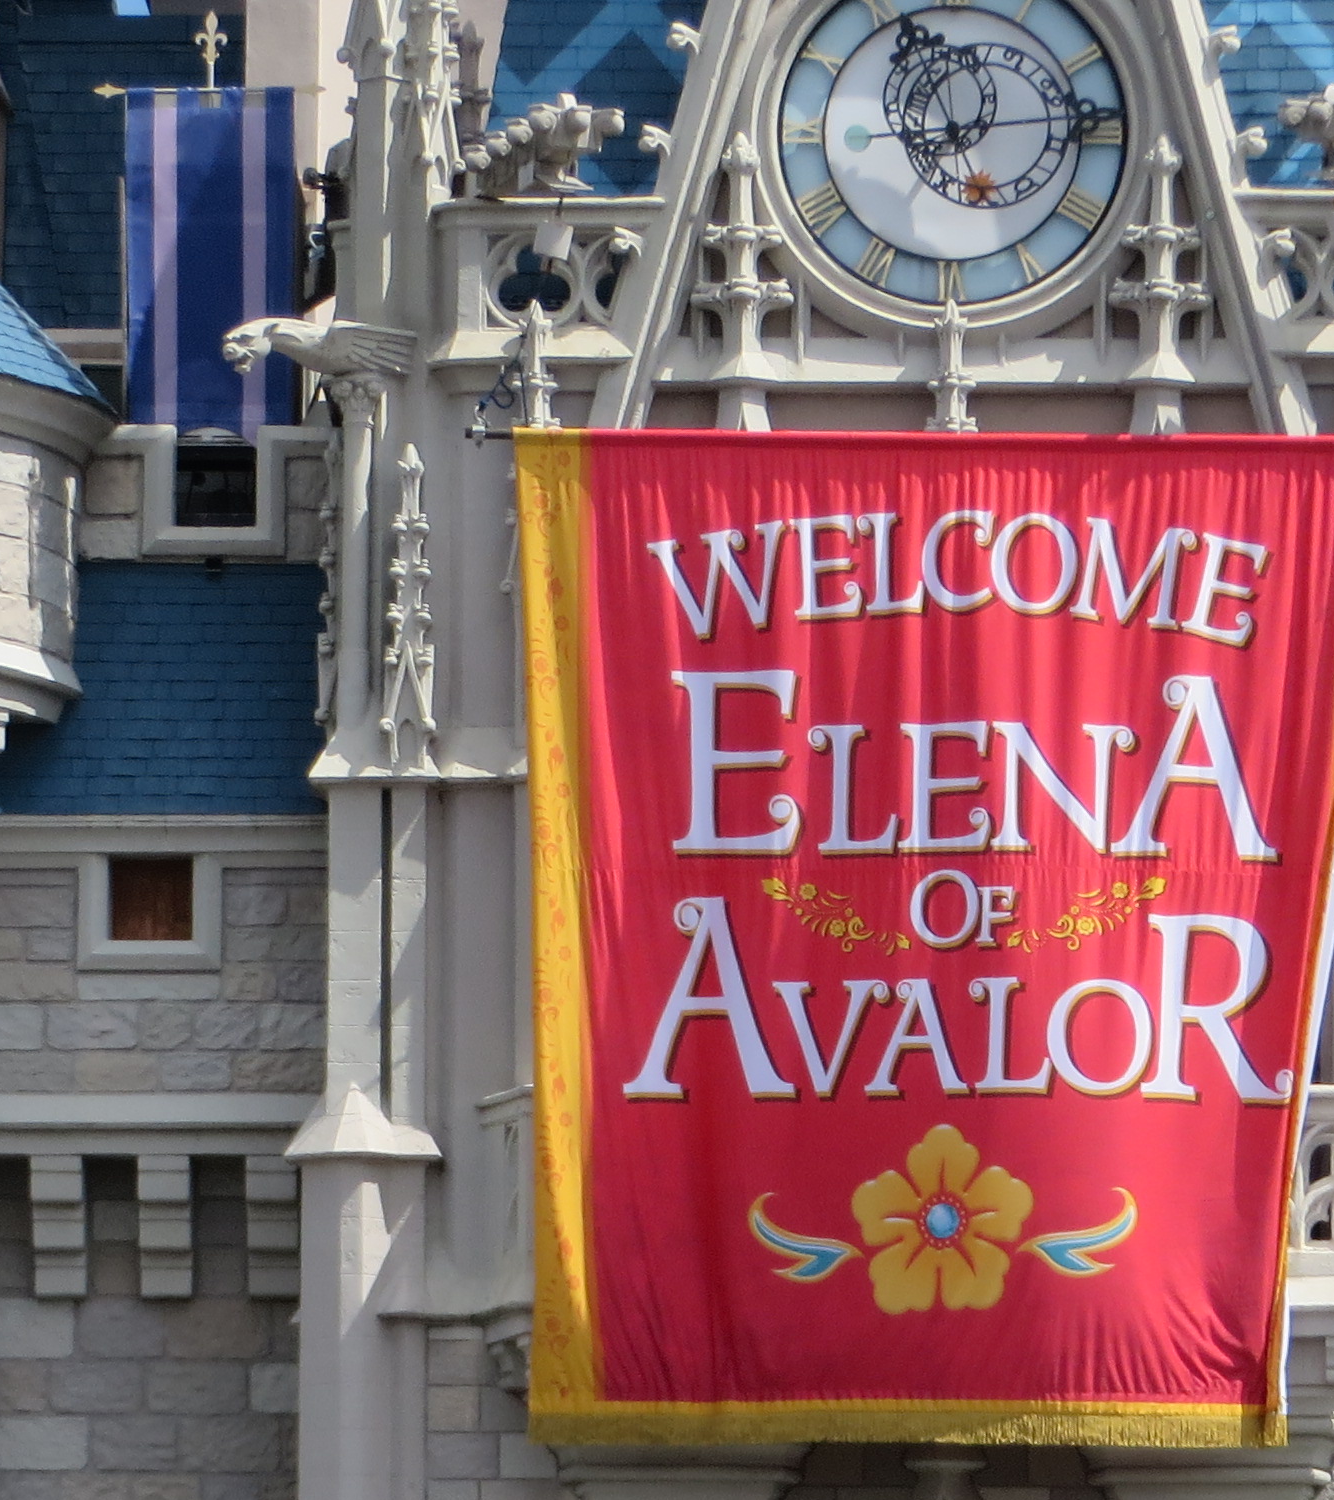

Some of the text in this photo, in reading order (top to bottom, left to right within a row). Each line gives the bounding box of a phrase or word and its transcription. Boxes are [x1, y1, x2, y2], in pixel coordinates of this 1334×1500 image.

[1017, 242, 1047, 284] V
[646, 510, 1270, 647] WELCOME
[670, 668, 1281, 863] ELENA
[909, 868, 1017, 952] OF
[622, 895, 1294, 1103] AVALOR
